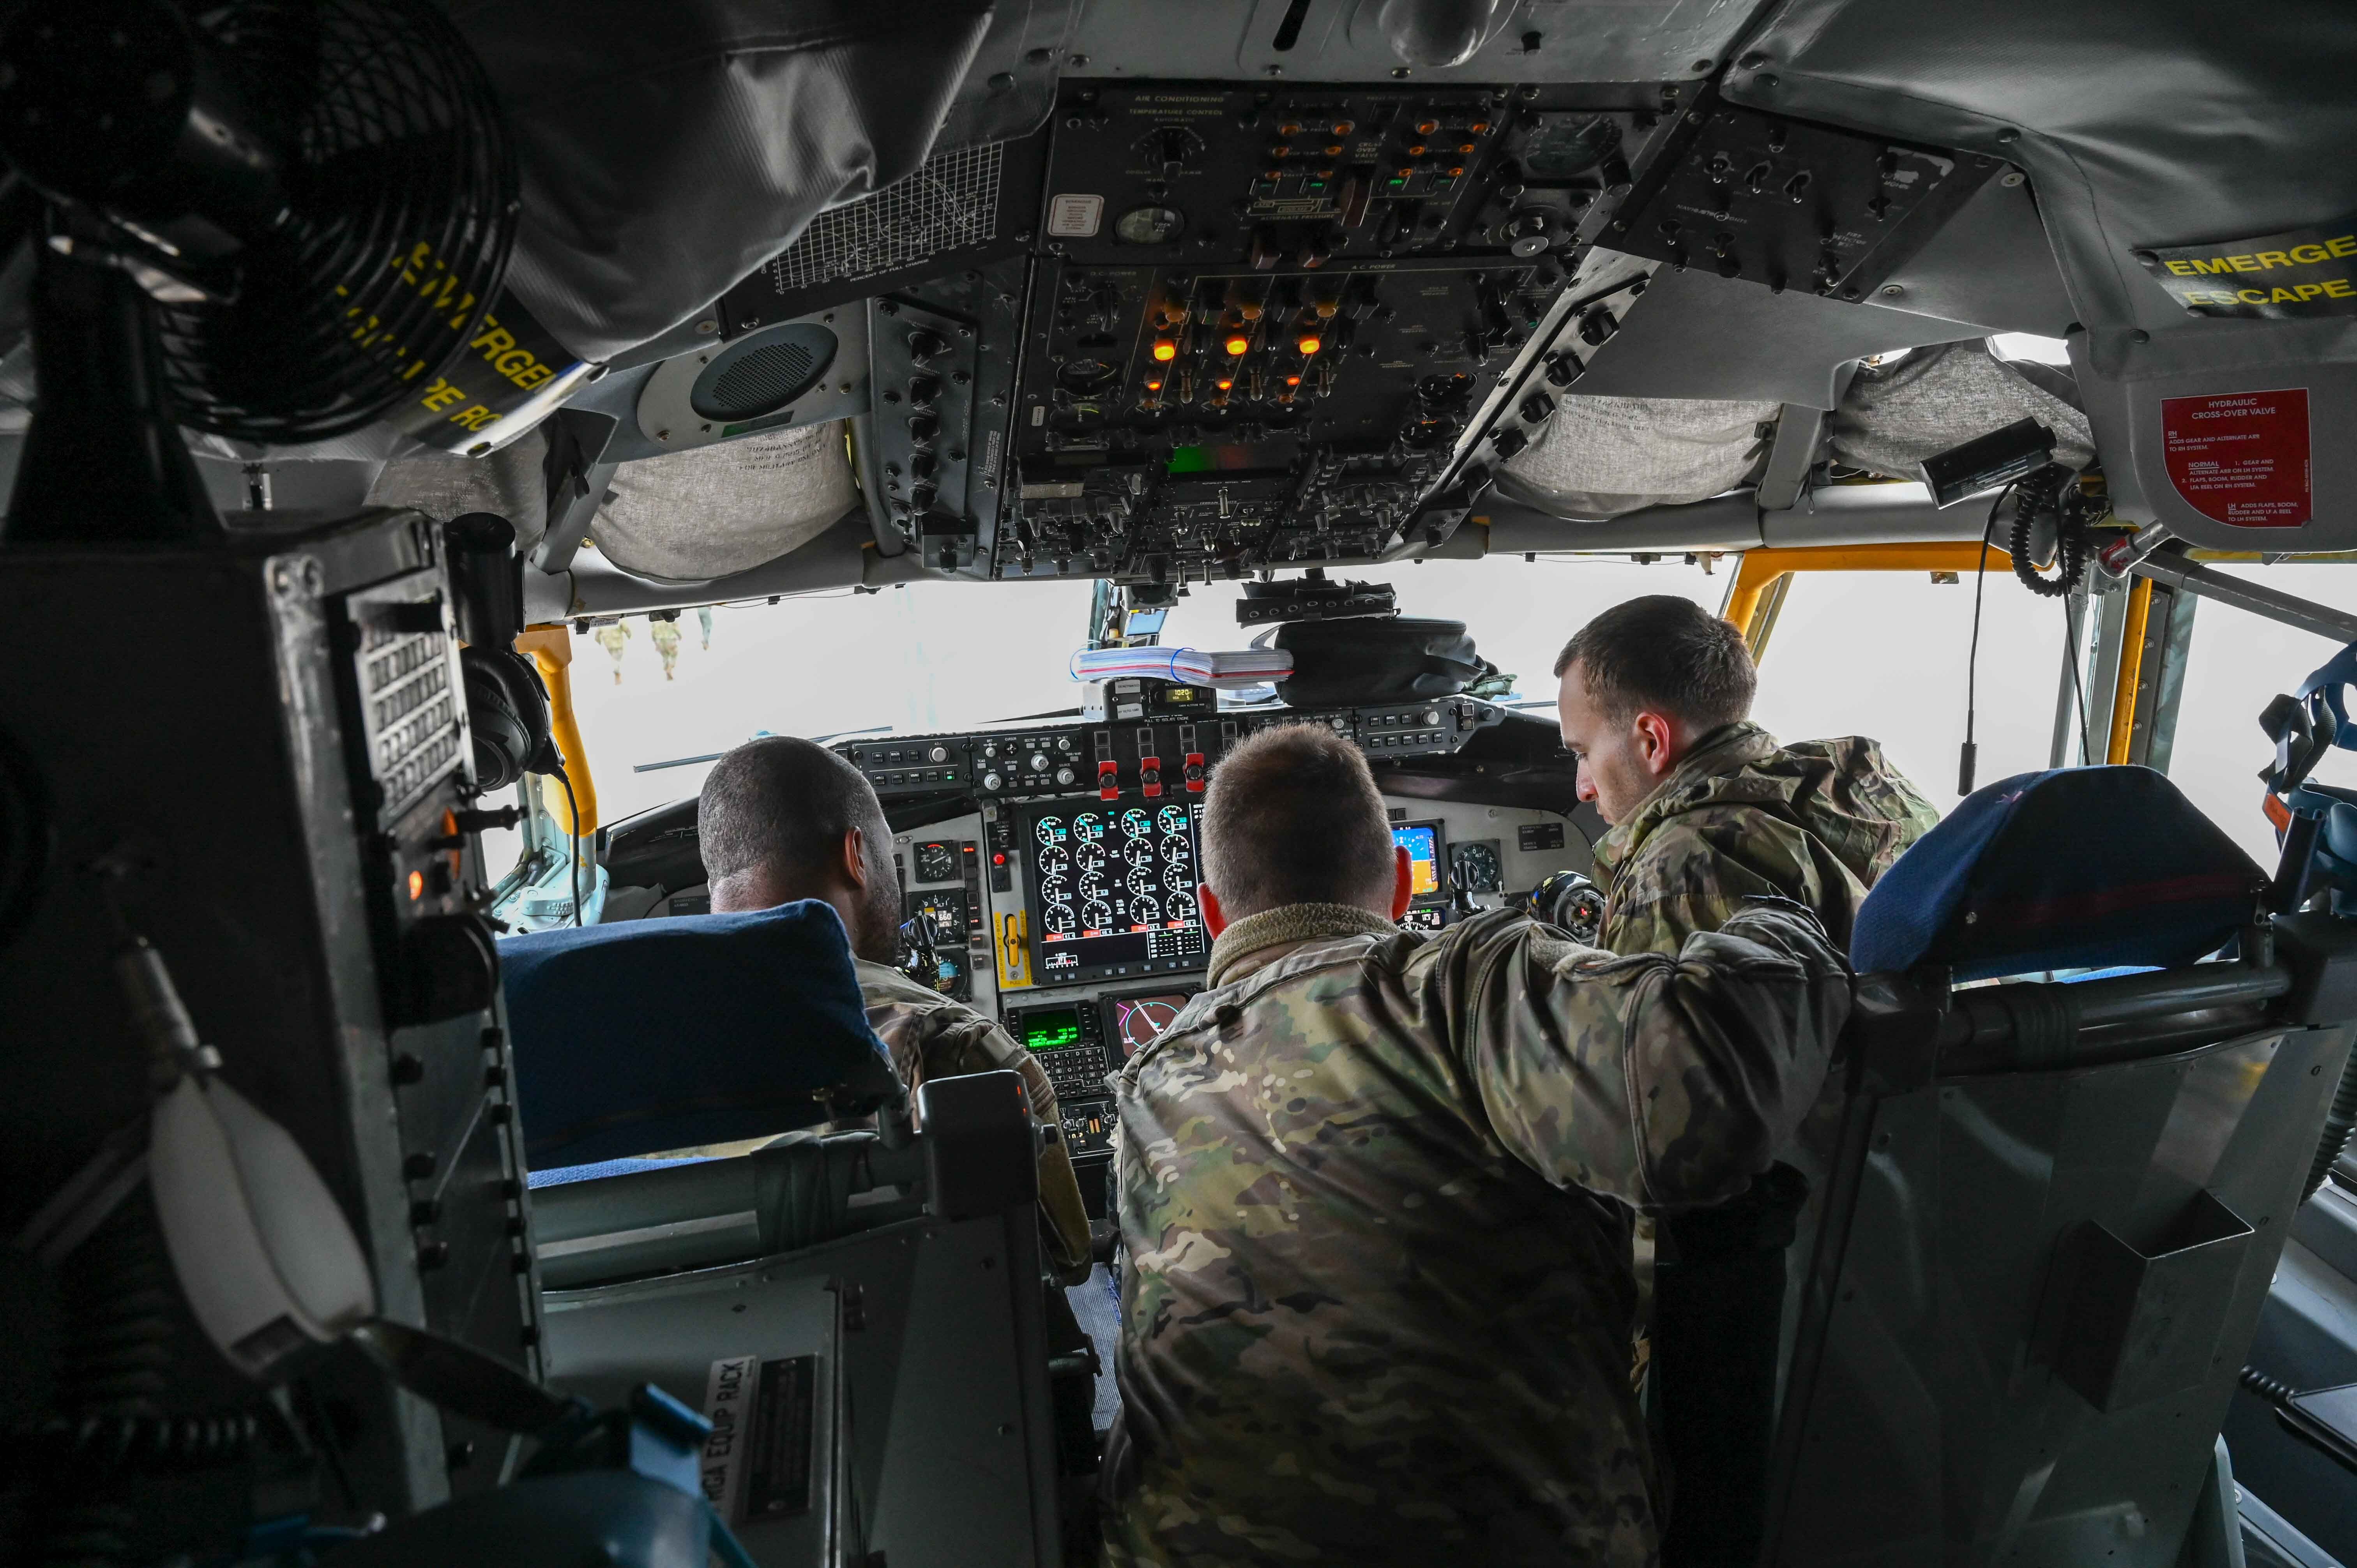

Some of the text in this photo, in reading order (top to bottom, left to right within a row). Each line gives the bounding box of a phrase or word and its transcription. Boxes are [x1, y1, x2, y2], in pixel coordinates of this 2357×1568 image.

[1155, 95, 1224, 103] CONDITIONING
[2164, 235, 2357, 276] EMERGE
[850, 272, 876, 283] PERCENT
[905, 258, 930, 268] CHARGE
[2182, 278, 2357, 305] ESCAPE
[2191, 407, 2276, 420] CROSS-OVER VALVE
[2208, 398, 2258, 408] HYDRAULIC
[716, 1361, 744, 1402] RACK
